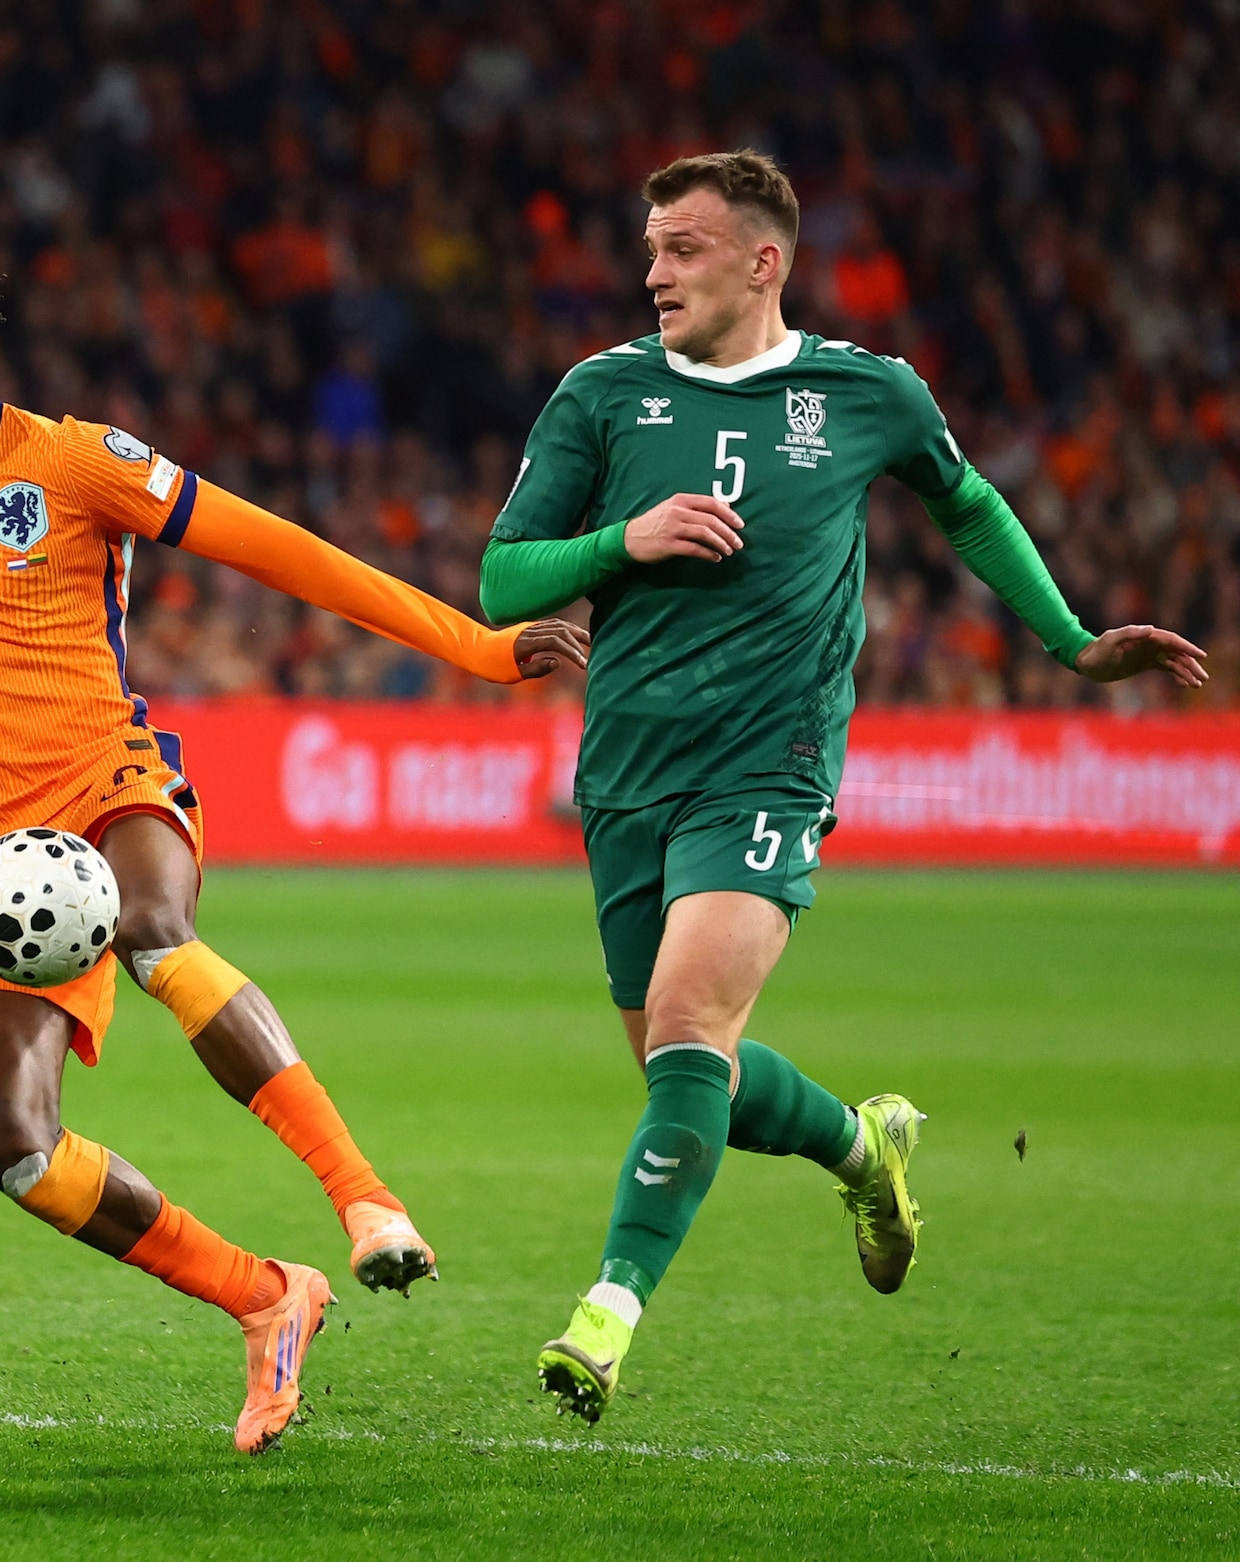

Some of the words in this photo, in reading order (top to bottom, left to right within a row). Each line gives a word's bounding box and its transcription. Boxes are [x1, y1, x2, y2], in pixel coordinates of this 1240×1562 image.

[637, 415, 674, 425] hummel
[787, 434, 825, 447] LIETUVA
[712, 430, 748, 504] 5
[744, 811, 783, 872] 5
